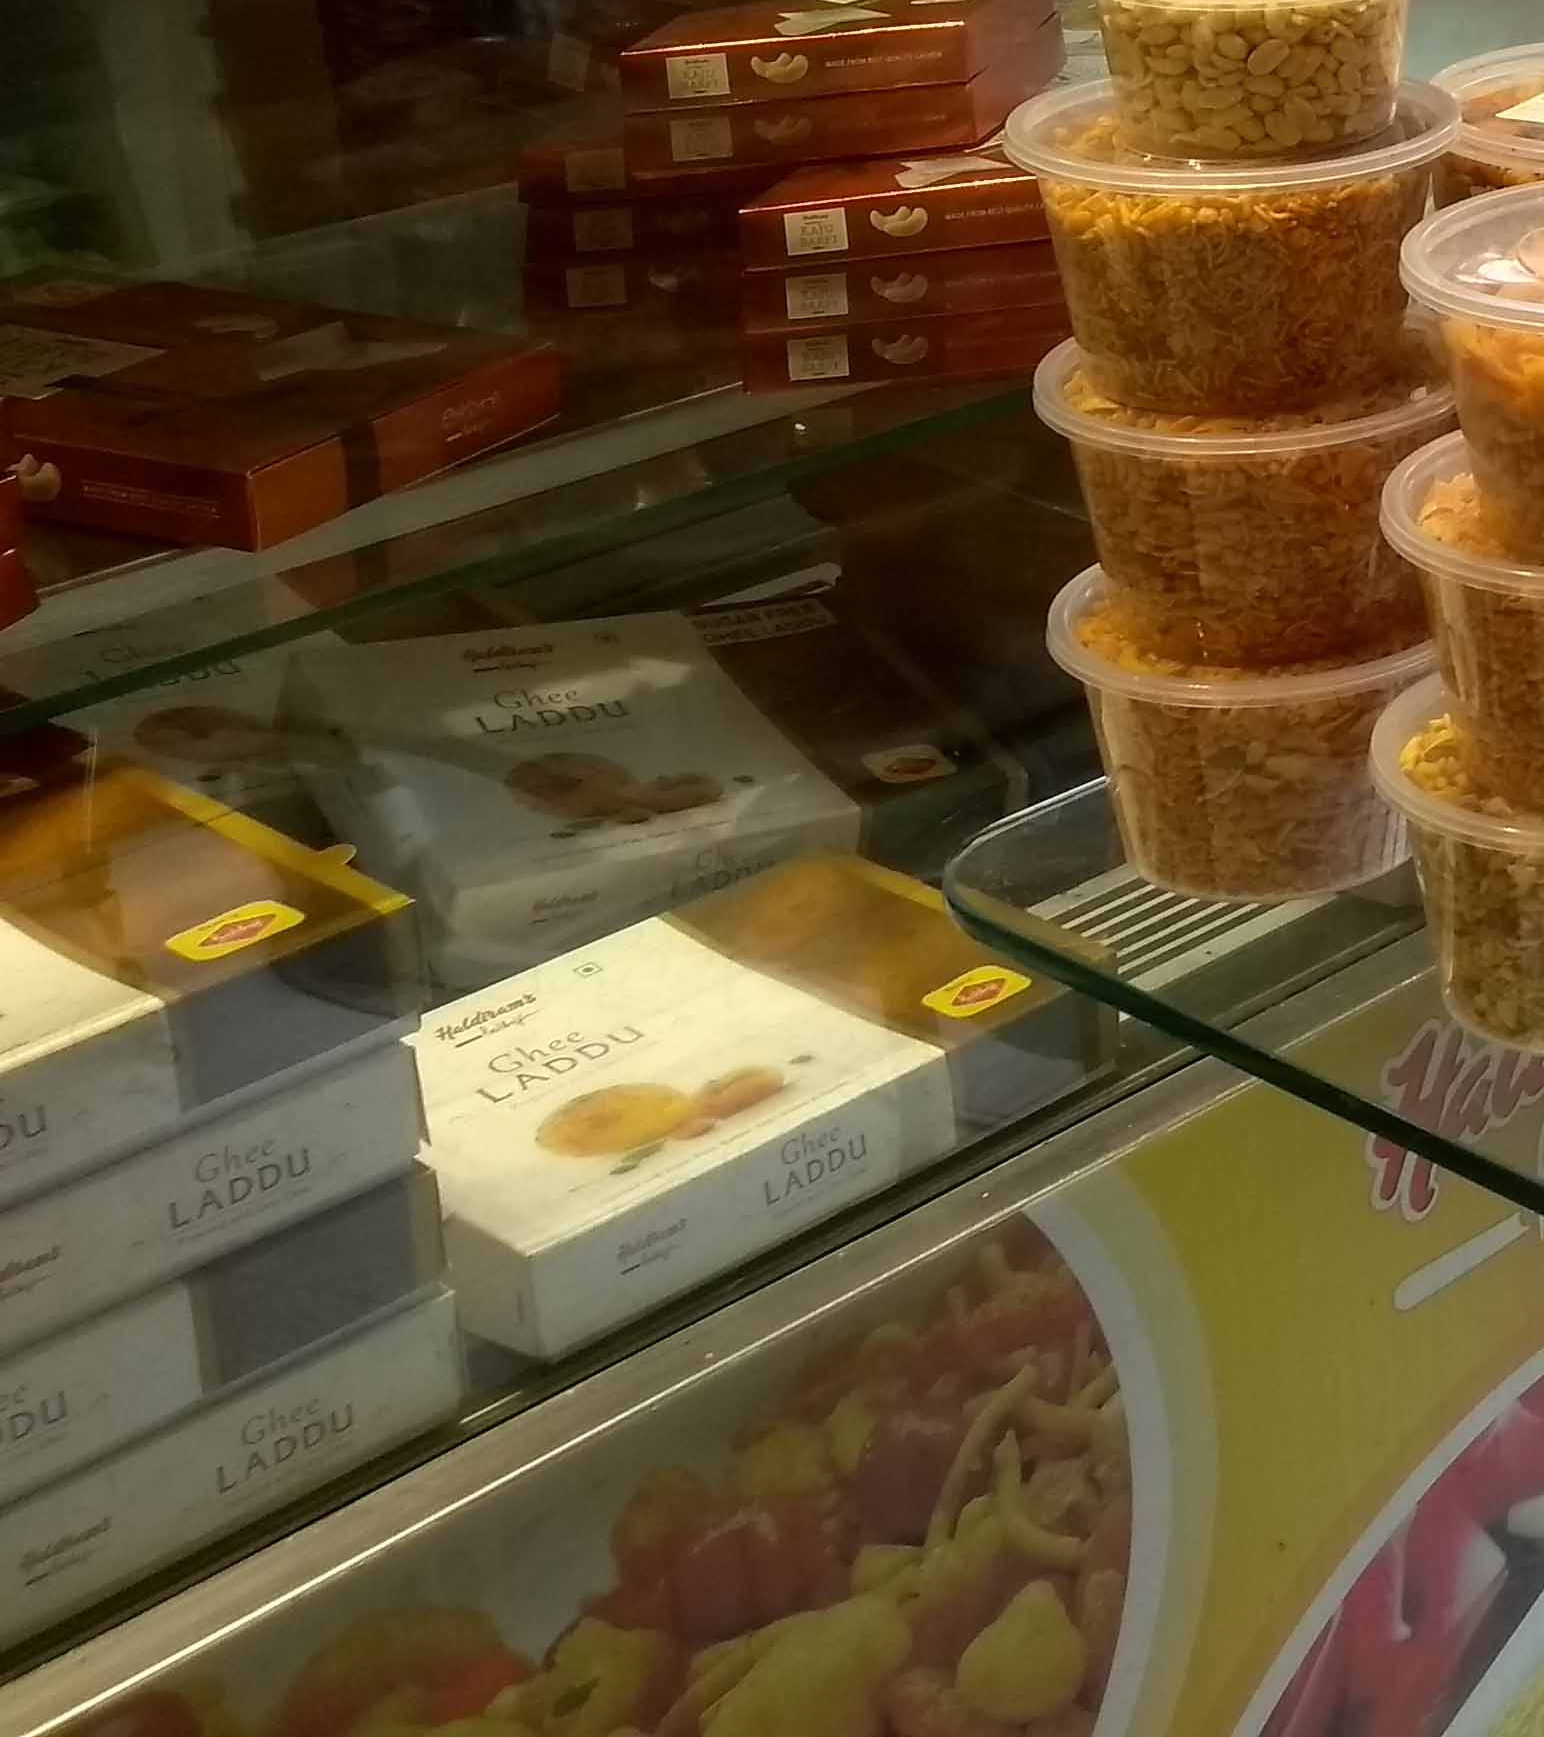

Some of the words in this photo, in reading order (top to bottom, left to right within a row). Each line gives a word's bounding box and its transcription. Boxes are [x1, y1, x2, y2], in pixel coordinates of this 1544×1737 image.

[474, 697, 631, 735] LADDU
[493, 687, 579, 711] Ghee
[475, 1025, 646, 1105] LADDU
[486, 1029, 586, 1074] Ghee
[194, 1140, 276, 1184] Ghee
[779, 1125, 842, 1165] Ghee
[168, 1148, 312, 1230] LADDU
[762, 1133, 868, 1207] LADDU
[240, 1399, 322, 1447] Ghee
[216, 1403, 353, 1495] LADDU
